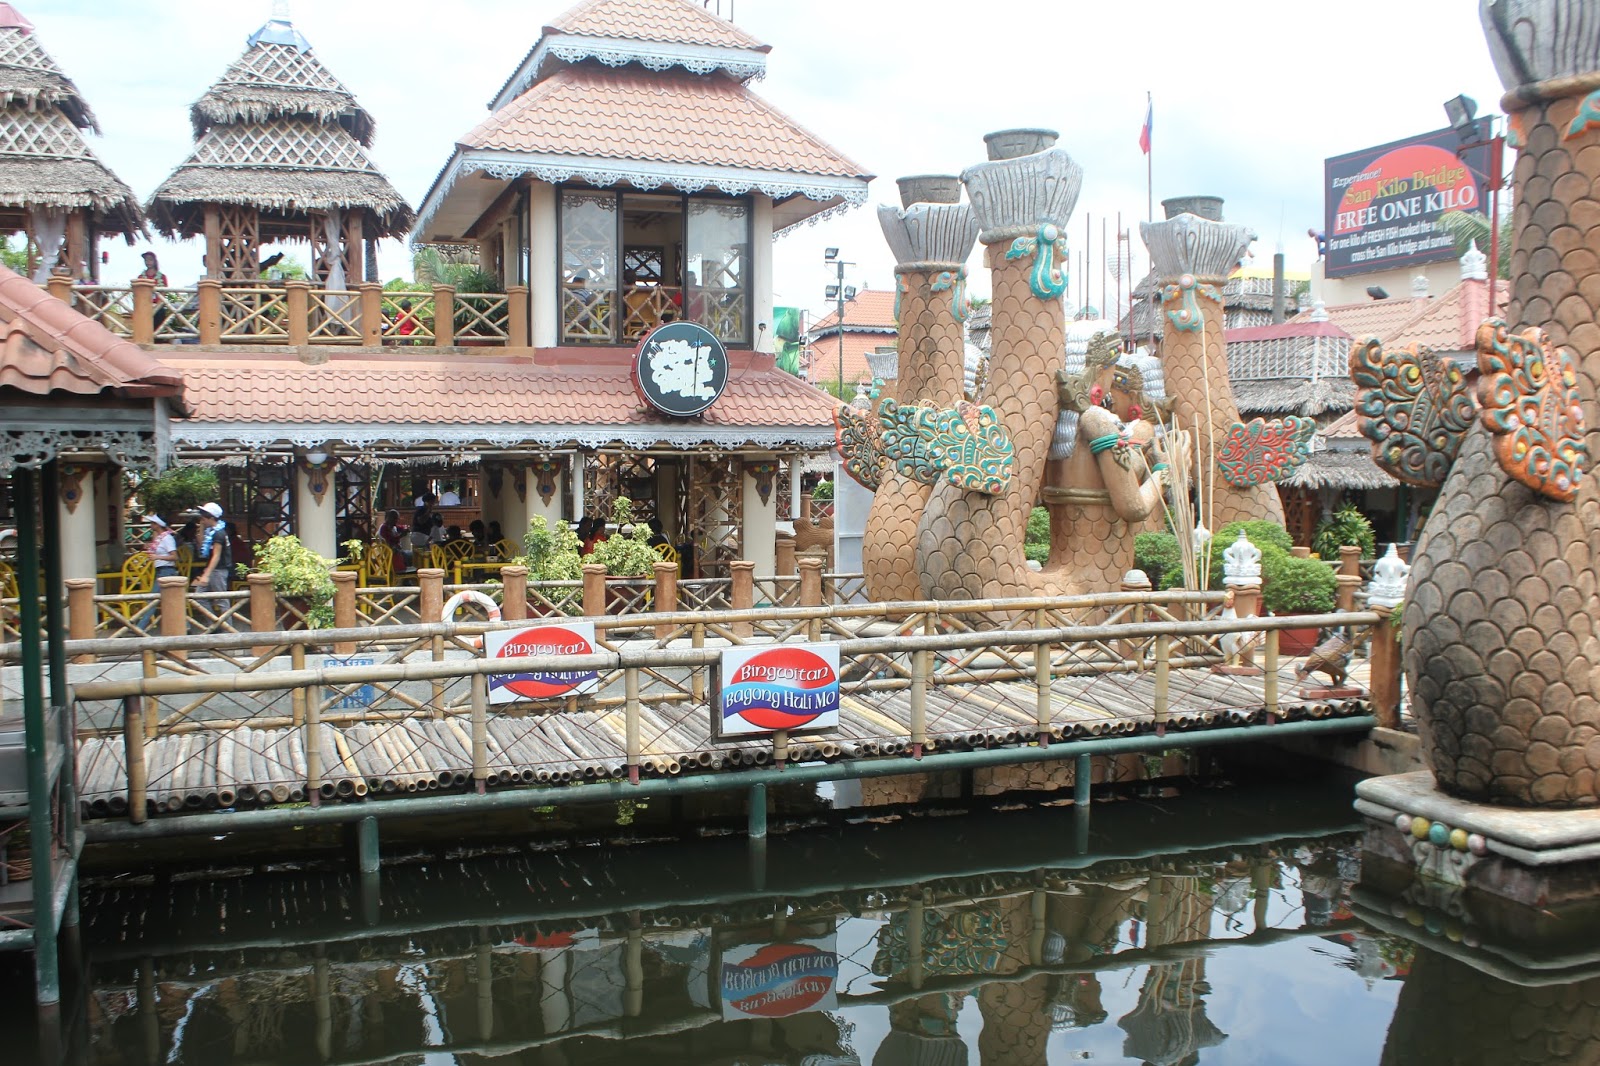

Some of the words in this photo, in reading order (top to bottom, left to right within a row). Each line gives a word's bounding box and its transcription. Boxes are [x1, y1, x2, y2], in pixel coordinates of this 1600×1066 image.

[1345, 186, 1371, 206] San
[1376, 178, 1408, 199] Kilo
[1411, 165, 1465, 191] Bridge
[1337, 206, 1378, 231] FREE
[1381, 196, 1422, 222] ONE
[1425, 185, 1475, 213] KILO
[1330, 239, 1339, 250] For
[1339, 239, 1350, 249] one
[1350, 233, 1360, 246] kilo
[1361, 231, 1368, 245] of
[1368, 229, 1386, 243] FRESH
[1386, 226, 1399, 239] FISH
[1399, 221, 1420, 237] cooked
[1420, 220, 1431, 233] the
[1351, 251, 1366, 262] cross
[1366, 247, 1375, 259] the
[1376, 246, 1387, 257] San
[1387, 242, 1399, 255] Kilo
[1399, 239, 1418, 255] bridge
[1418, 236, 1430, 250] and
[504, 641, 585, 657] Bingwitan
[741, 664, 829, 681] Bingwitan
[726, 687, 780, 709] Bagong
[784, 690, 812, 710] Huli
